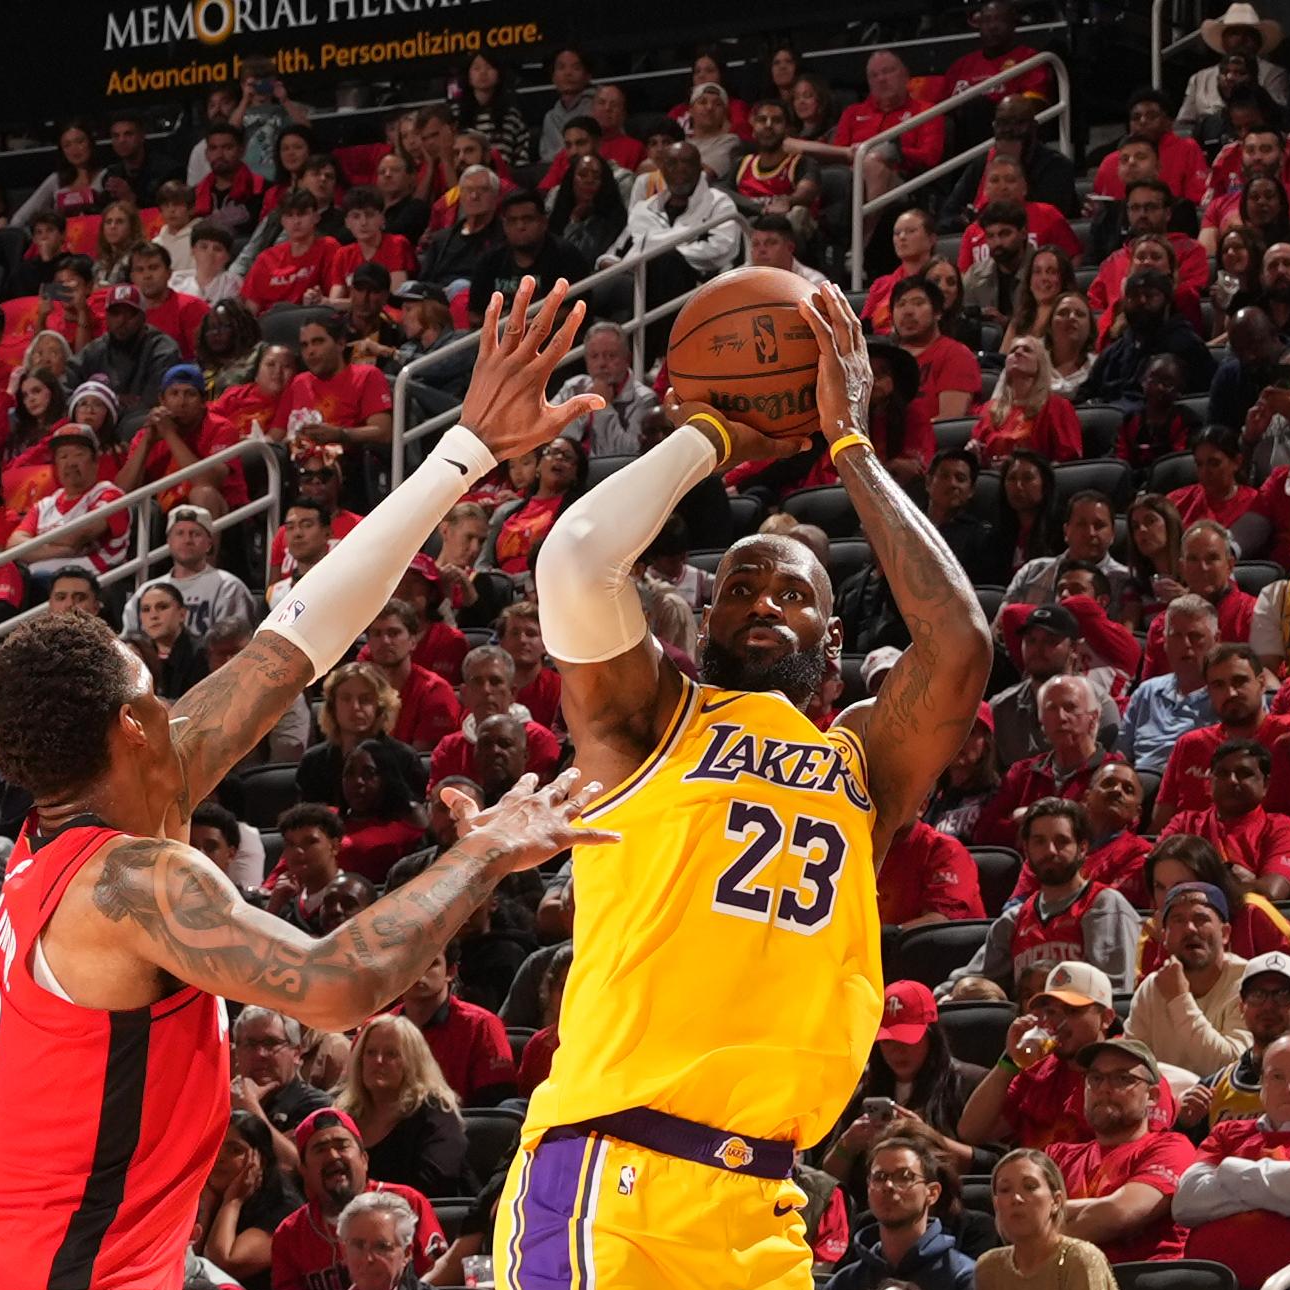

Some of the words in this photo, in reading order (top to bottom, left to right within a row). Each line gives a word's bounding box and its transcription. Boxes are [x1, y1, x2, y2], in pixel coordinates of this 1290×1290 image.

[104, 0, 318, 51] MEMORIAL
[233, 48, 314, 79] hlth.
[486, 22, 543, 47] care.
[682, 722, 875, 813] LAKERS
[710, 800, 849, 938] 23
